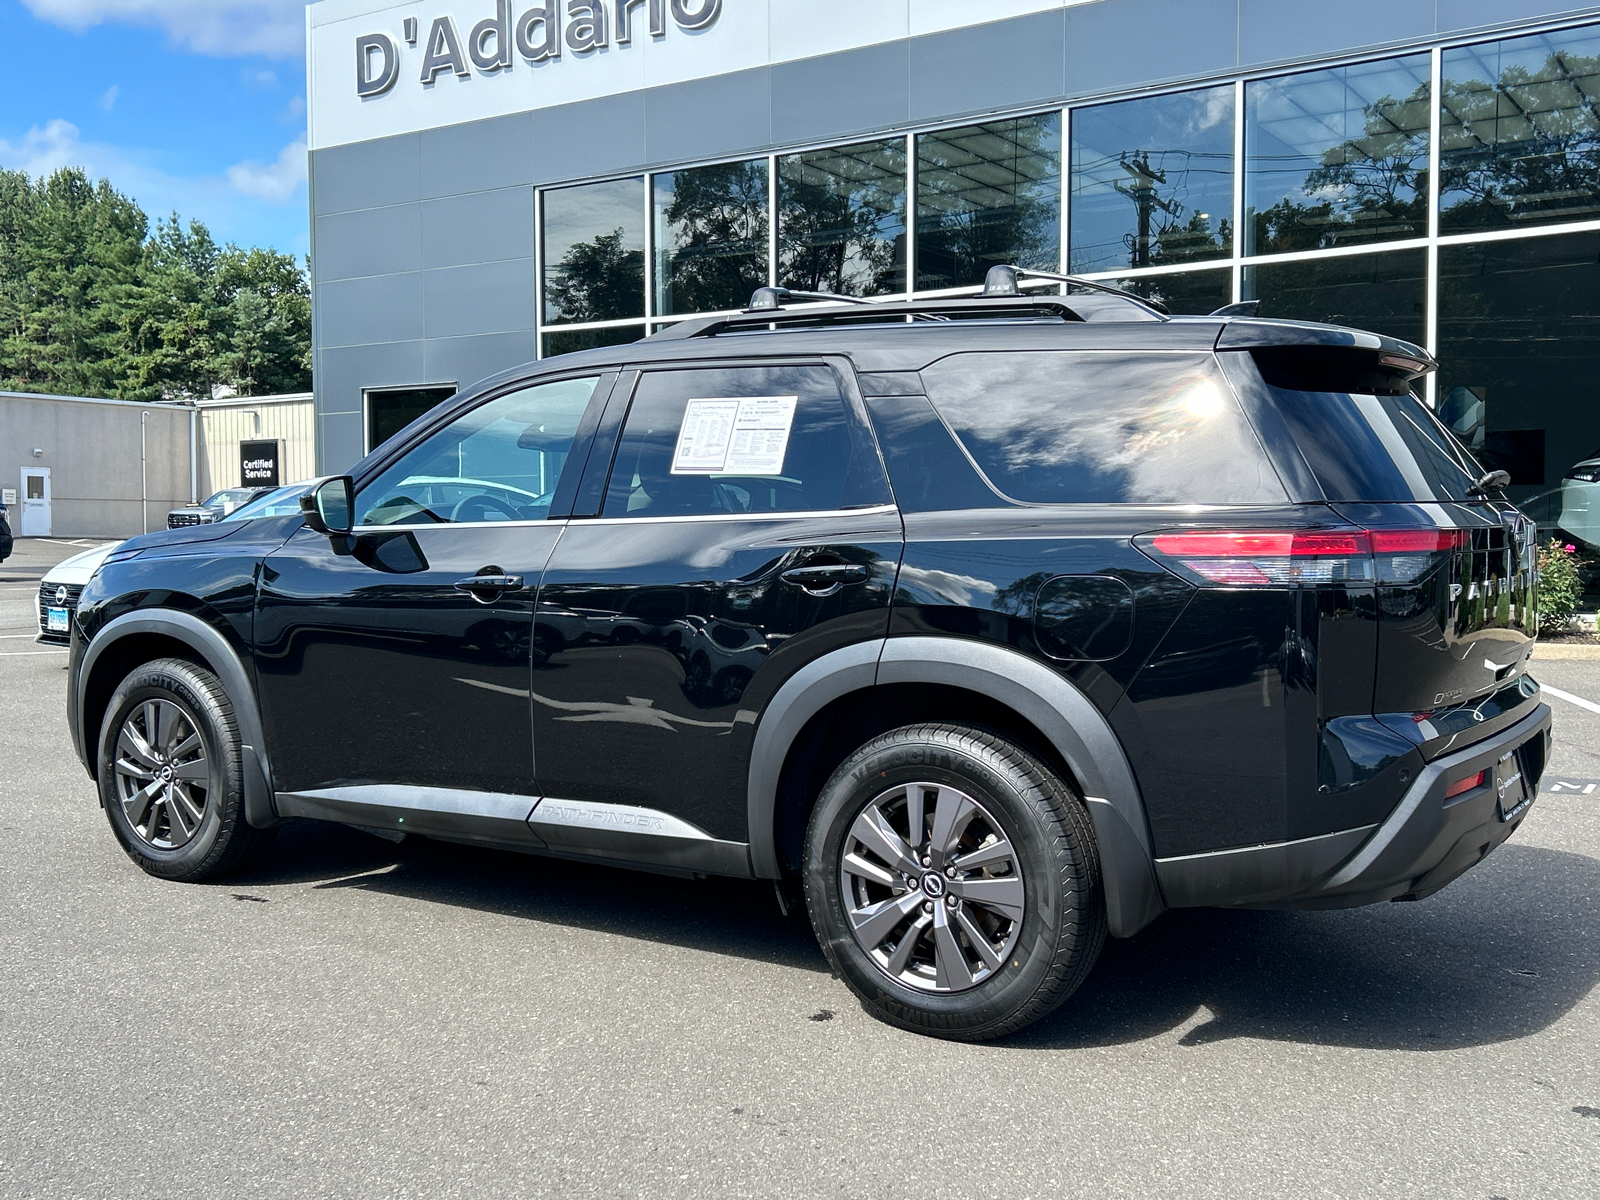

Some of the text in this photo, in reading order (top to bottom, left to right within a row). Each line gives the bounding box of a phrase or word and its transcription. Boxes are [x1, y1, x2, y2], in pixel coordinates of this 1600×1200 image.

[243, 459, 273, 469] Certified
[245, 469, 272, 478] Service
[851, 749, 1007, 793] VELOCITY CROSS
[538, 805, 664, 829] PATHFINDER
